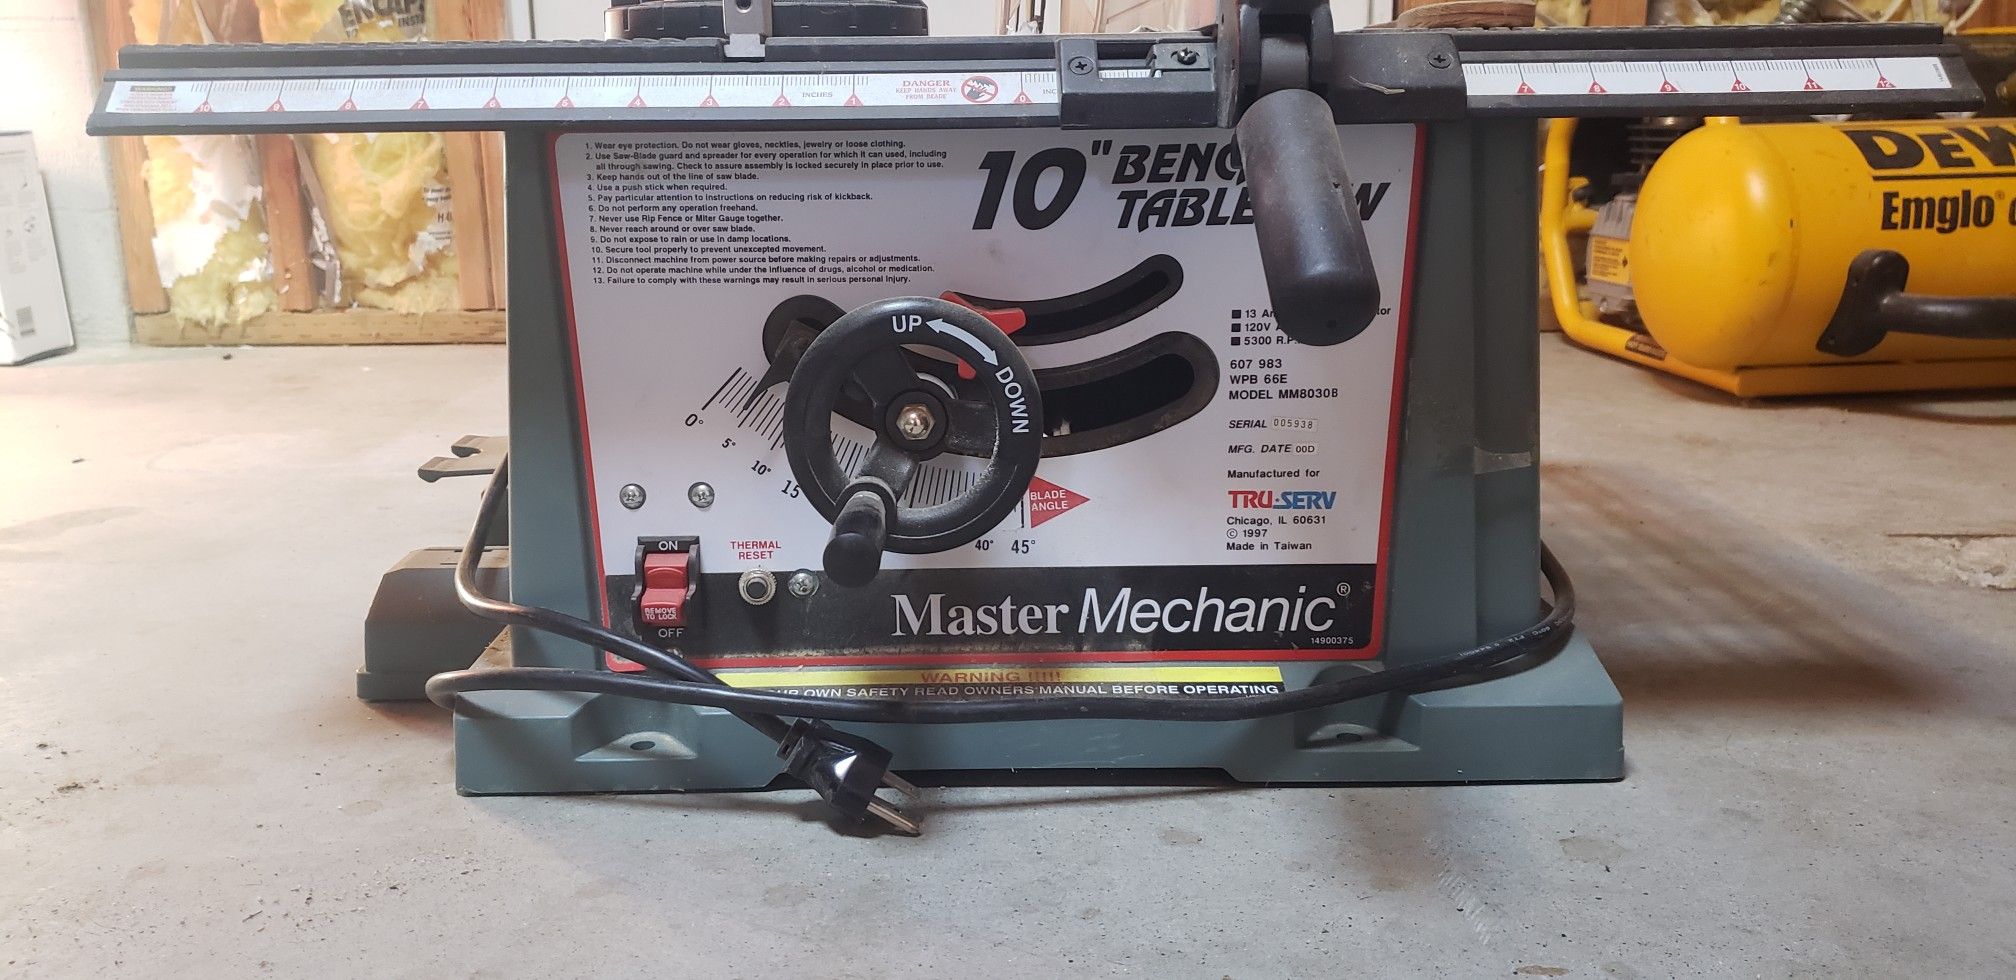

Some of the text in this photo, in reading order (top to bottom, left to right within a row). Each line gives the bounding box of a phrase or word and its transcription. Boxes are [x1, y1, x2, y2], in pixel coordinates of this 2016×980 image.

[1734, 82, 1746, 91] 10
[1806, 80, 1817, 90] 11
[1879, 80, 1890, 88] 12
[594, 141, 615, 149] Wear
[617, 142, 632, 151] eye
[634, 141, 679, 151] protection.
[681, 140, 693, 149] Do
[695, 140, 708, 149] not
[732, 140, 762, 150] gloves,
[845, 140, 868, 148] loose
[870, 140, 905, 150] clothing.
[597, 193, 613, 204] Pay
[656, 193, 693, 201] attention
[694, 193, 703, 201] to
[705, 193, 754, 201] instructions
[768, 192, 805, 203] reducing
[806, 192, 822, 200] risk
[824, 192, 832, 200] of
[834, 192, 873, 200] kickback.
[598, 204, 609, 212] Do
[611, 204, 625, 212] not
[627, 204, 660, 214] perform
[661, 205, 677, 214] any
[679, 203, 718, 214] operation
[719, 203, 758, 211] freehand.
[599, 225, 623, 233] Never
[625, 225, 648, 233] reach
[649, 225, 679, 233] around
[730, 224, 755, 233] blade.
[605, 255, 651, 263] Disconnect
[653, 255, 688, 263] machine
[689, 255, 710, 263] from
[711, 256, 737, 265] power
[767, 254, 795, 263] before
[796, 254, 826, 265] making
[828, 254, 856, 264] repairs
[868, 254, 920, 264] adjustments.
[606, 276, 635, 284] Failure
[636, 276, 646, 284] to
[647, 276, 677, 286] comply
[678, 276, 697, 284] with
[698, 275, 721, 284] these
[722, 275, 761, 285] warnings
[762, 276, 780, 285] may
[781, 275, 805, 283] result
[806, 275, 815, 283] in
[816, 275, 847, 283] serious
[848, 275, 883, 285] personal
[885, 274, 911, 285] injury.
[1245, 309, 1256, 318] 13
[1244, 322, 1271, 332] 120V
[1244, 336, 1302, 345] 5300 R.P.
[1230, 359, 1282, 369] 607 983
[892, 315, 1030, 433] UP DOWN
[1230, 374, 1288, 384] WPB 66E
[1229, 388, 1338, 400] MODEL MM8030B
[1228, 418, 1313, 429] SERIAL 005938
[1228, 445, 1255, 453] MFG.
[1261, 444, 1292, 453] DATE
[751, 460, 772, 475] 10°
[1227, 469, 1320, 478] Manufactured for
[1030, 490, 1066, 500] BLADE
[1031, 500, 1069, 511] ANGLE
[1227, 516, 1326, 525] Chicago, IL 60631
[1243, 529, 1268, 538] 1997
[658, 541, 678, 550] ON
[730, 540, 782, 549] THERMAL
[975, 540, 993, 551] 40°
[1011, 540, 1036, 554] 45°
[1227, 541, 1312, 550] Made in Taiwan
[738, 551, 774, 560] RESET
[890, 594, 1069, 636] Master
[658, 628, 684, 638] OFF
[804, 688, 842, 697] OWN
[846, 688, 906, 697] SAFETY
[915, 687, 959, 696] READ
[1039, 685, 1107, 695] MANUAL
[1112, 685, 1178, 694] BEFORE
[1183, 685, 1279, 694] OPERATING
